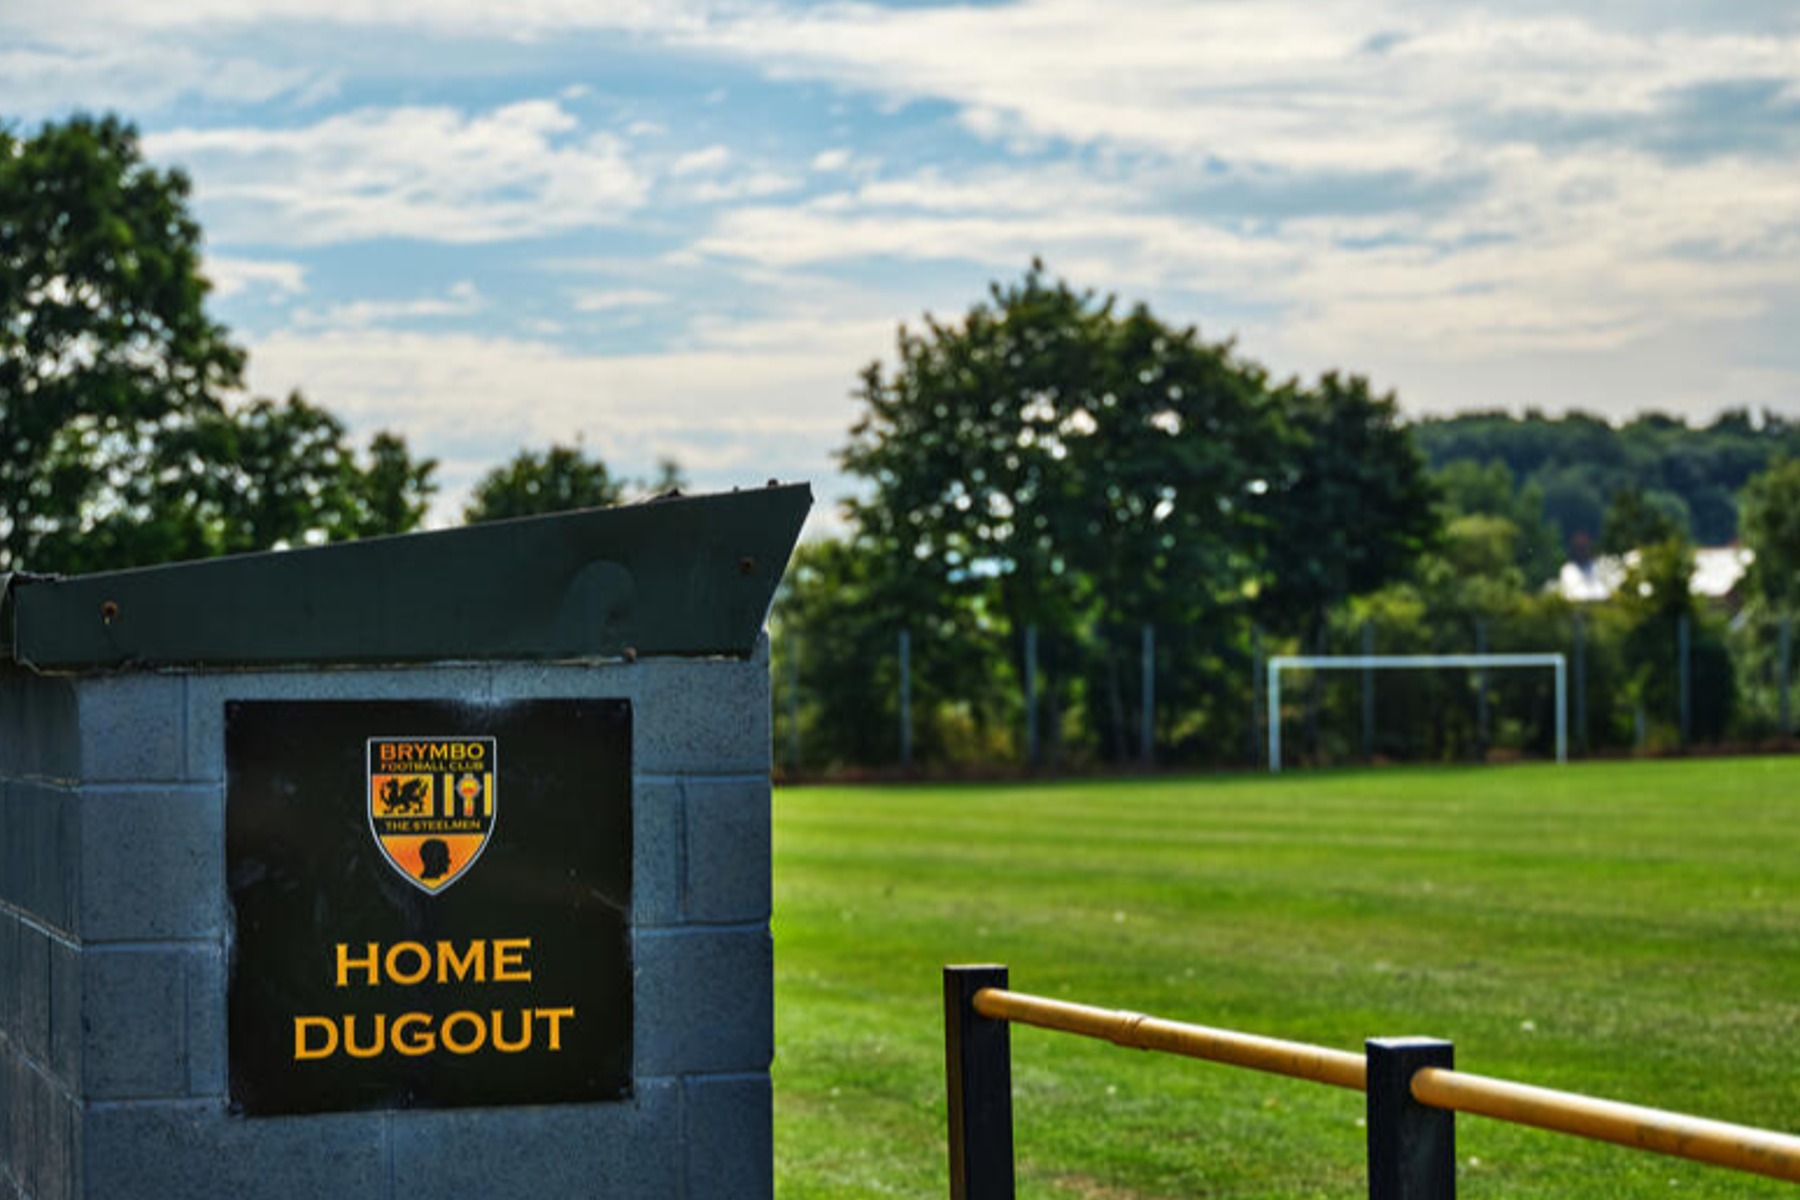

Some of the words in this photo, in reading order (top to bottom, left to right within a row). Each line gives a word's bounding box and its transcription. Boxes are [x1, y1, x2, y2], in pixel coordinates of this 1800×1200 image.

[380, 743, 485, 760] BRYMBO
[381, 761, 445, 771] FOOTBALL
[449, 761, 485, 770] CLUB
[385, 820, 410, 831] THE
[412, 820, 481, 830] STEELMEN
[336, 937, 532, 987] HOME
[294, 1006, 575, 1060] DUGOUT
